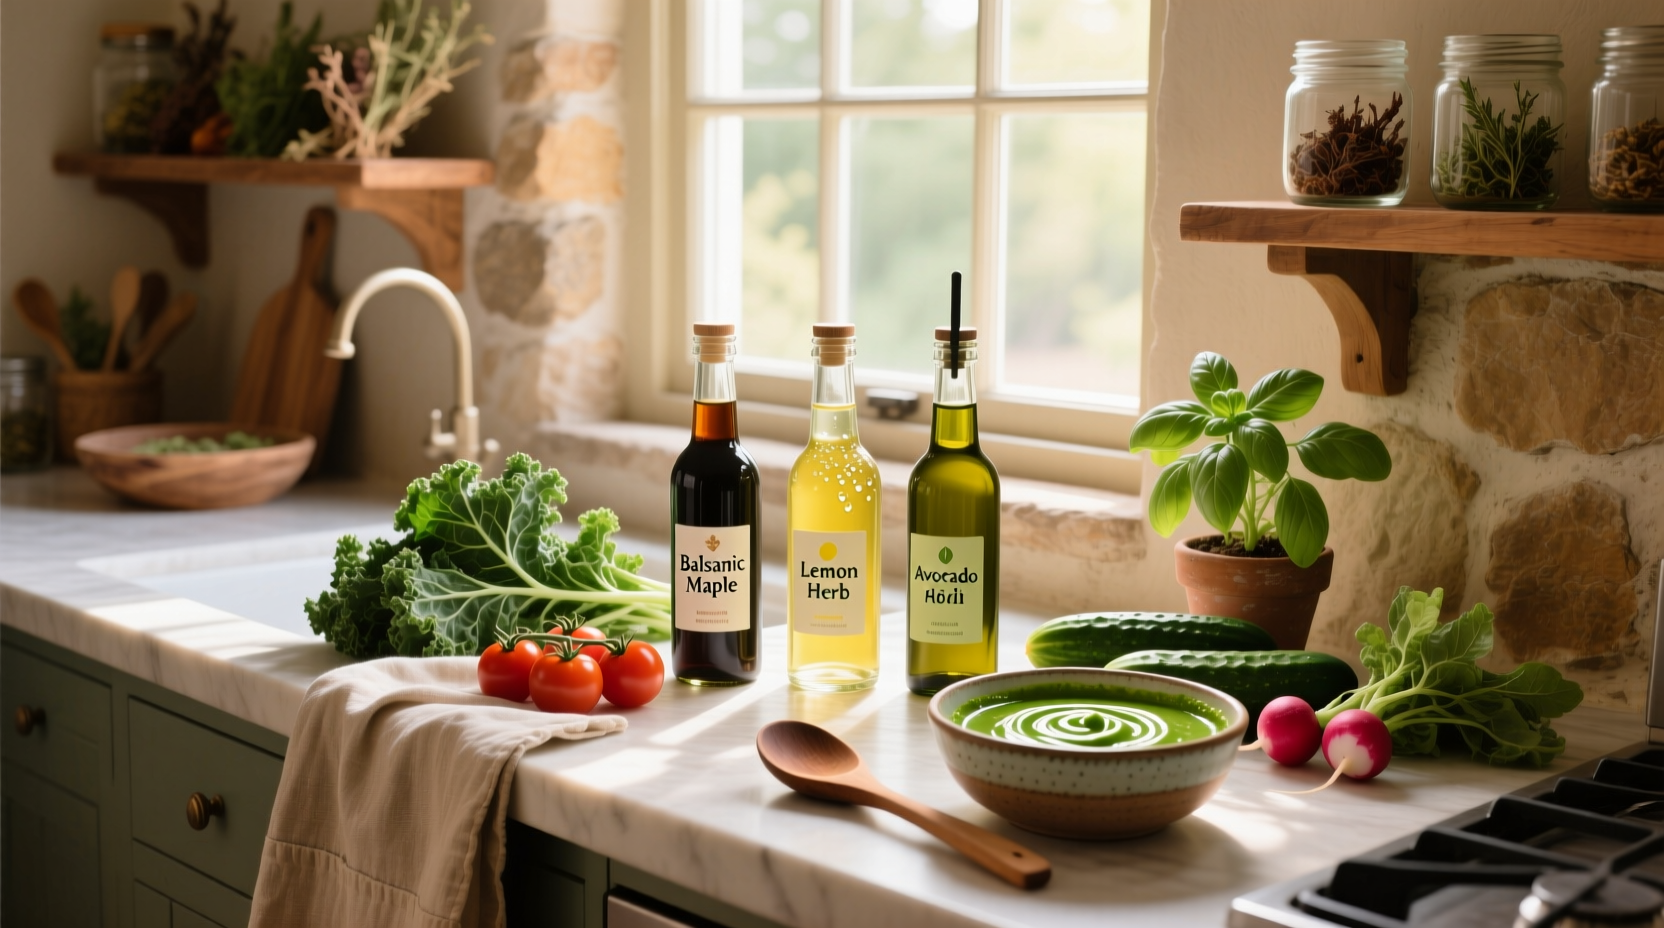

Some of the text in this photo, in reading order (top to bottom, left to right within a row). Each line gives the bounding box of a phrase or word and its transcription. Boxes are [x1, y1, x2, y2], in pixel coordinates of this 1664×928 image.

[680, 554, 746, 573] Balsanic
[801, 561, 858, 579] Lemon
[914, 565, 978, 584] Avocado
[685, 576, 738, 599] Maple
[807, 582, 850, 600] Herb
